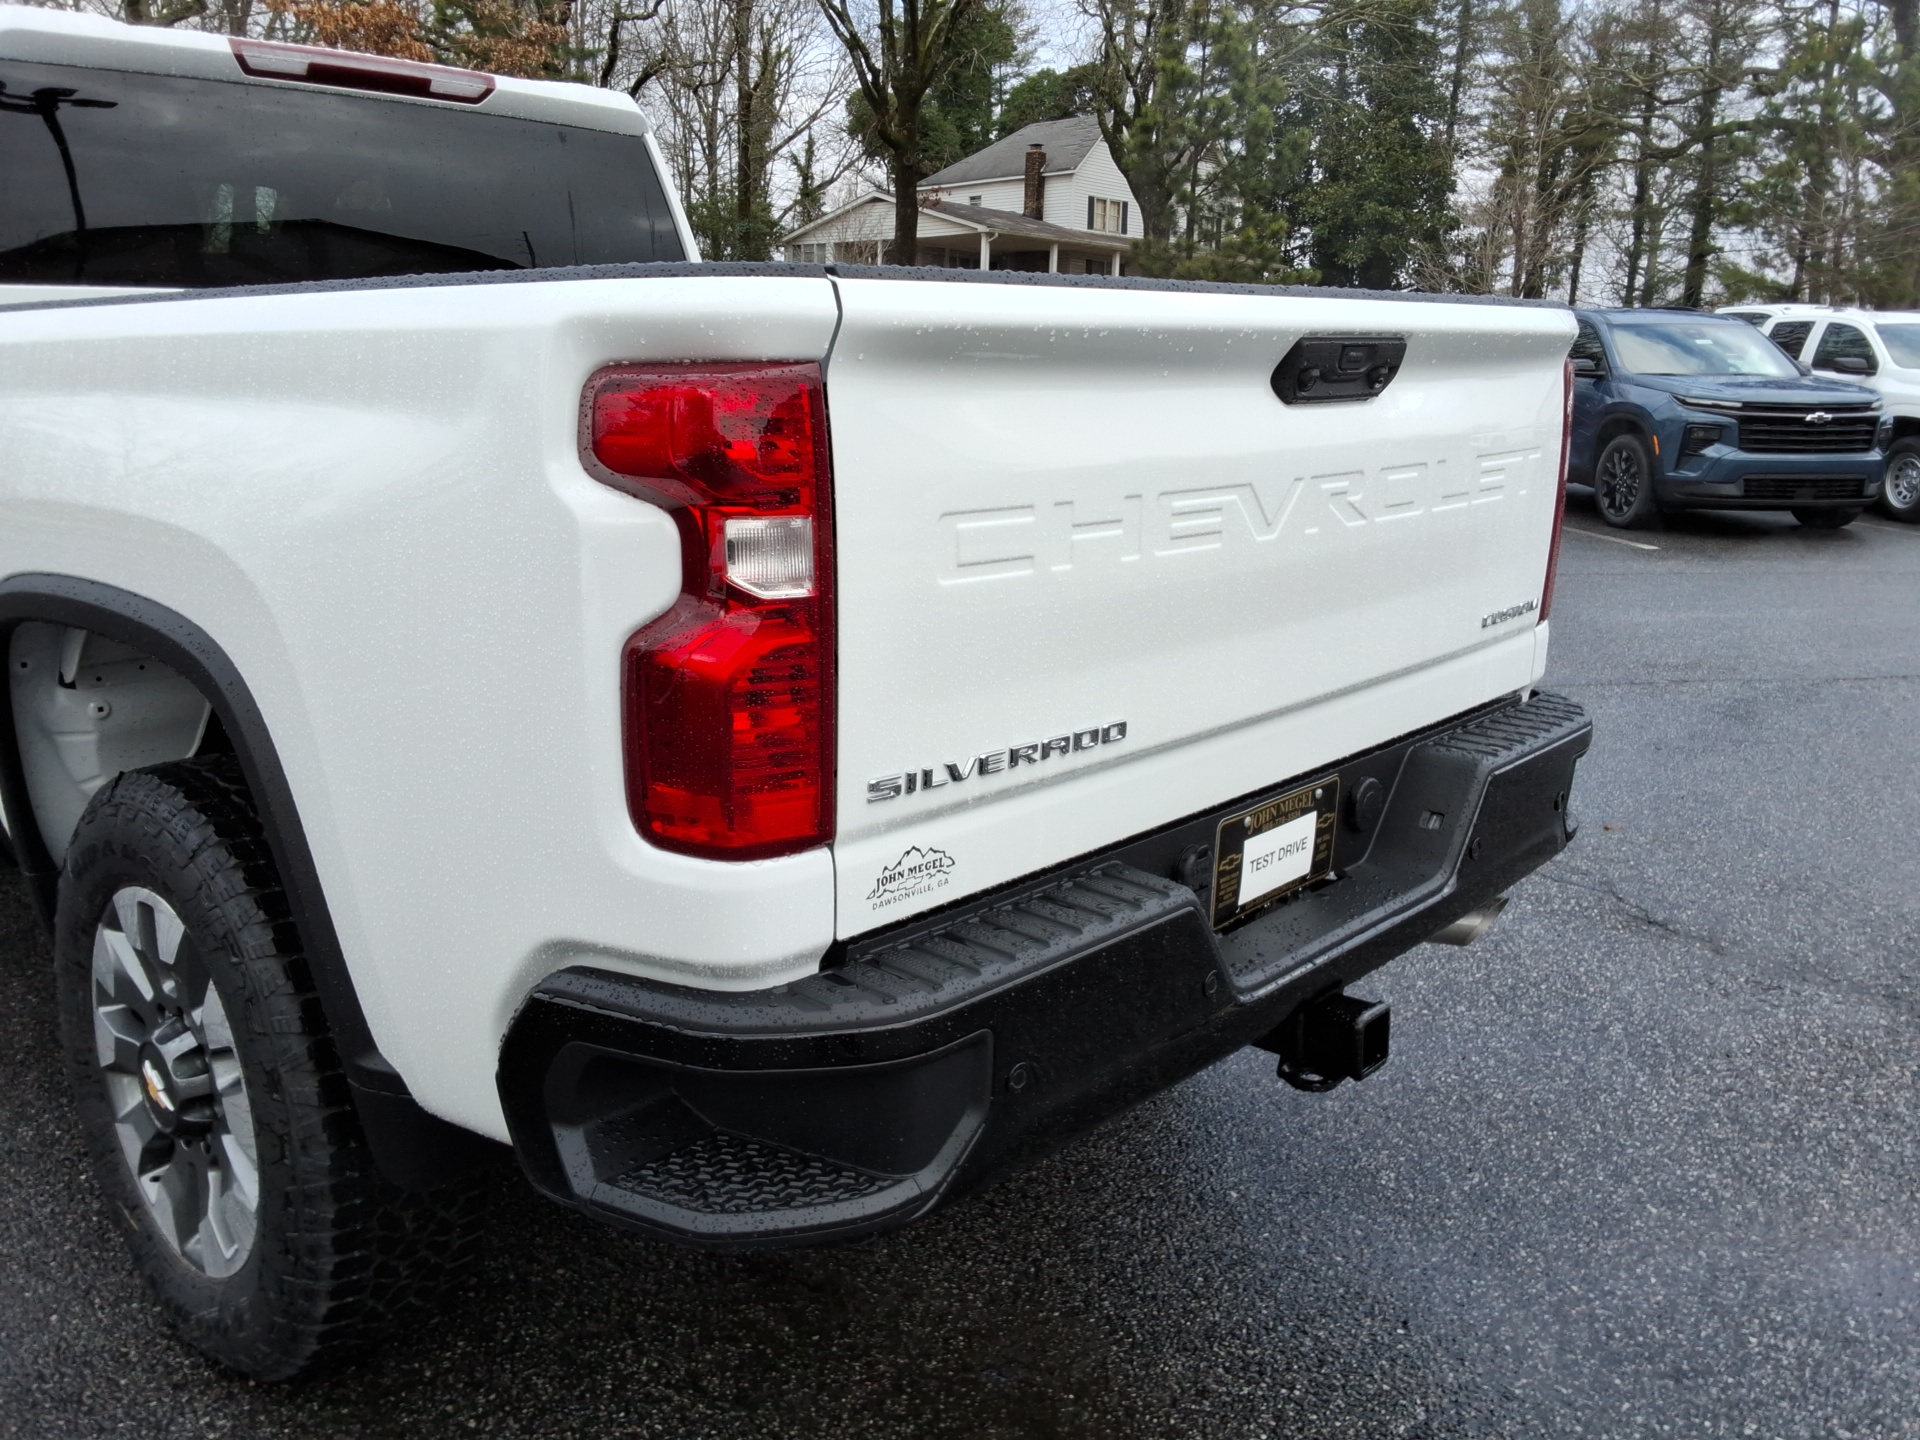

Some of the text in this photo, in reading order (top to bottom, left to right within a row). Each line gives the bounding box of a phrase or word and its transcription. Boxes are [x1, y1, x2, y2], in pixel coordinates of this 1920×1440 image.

[937, 446, 1542, 586] CHEVROLET
[866, 719, 1128, 804] SILVERADO
[1247, 791, 1314, 835] JOHN MEGEL
[876, 857, 945, 893] JOHN MEGEL
[1250, 851, 1276, 874] TEST
[1278, 836, 1308, 861] DRIVE
[872, 878, 949, 911] DAWSONVILLE, GA
